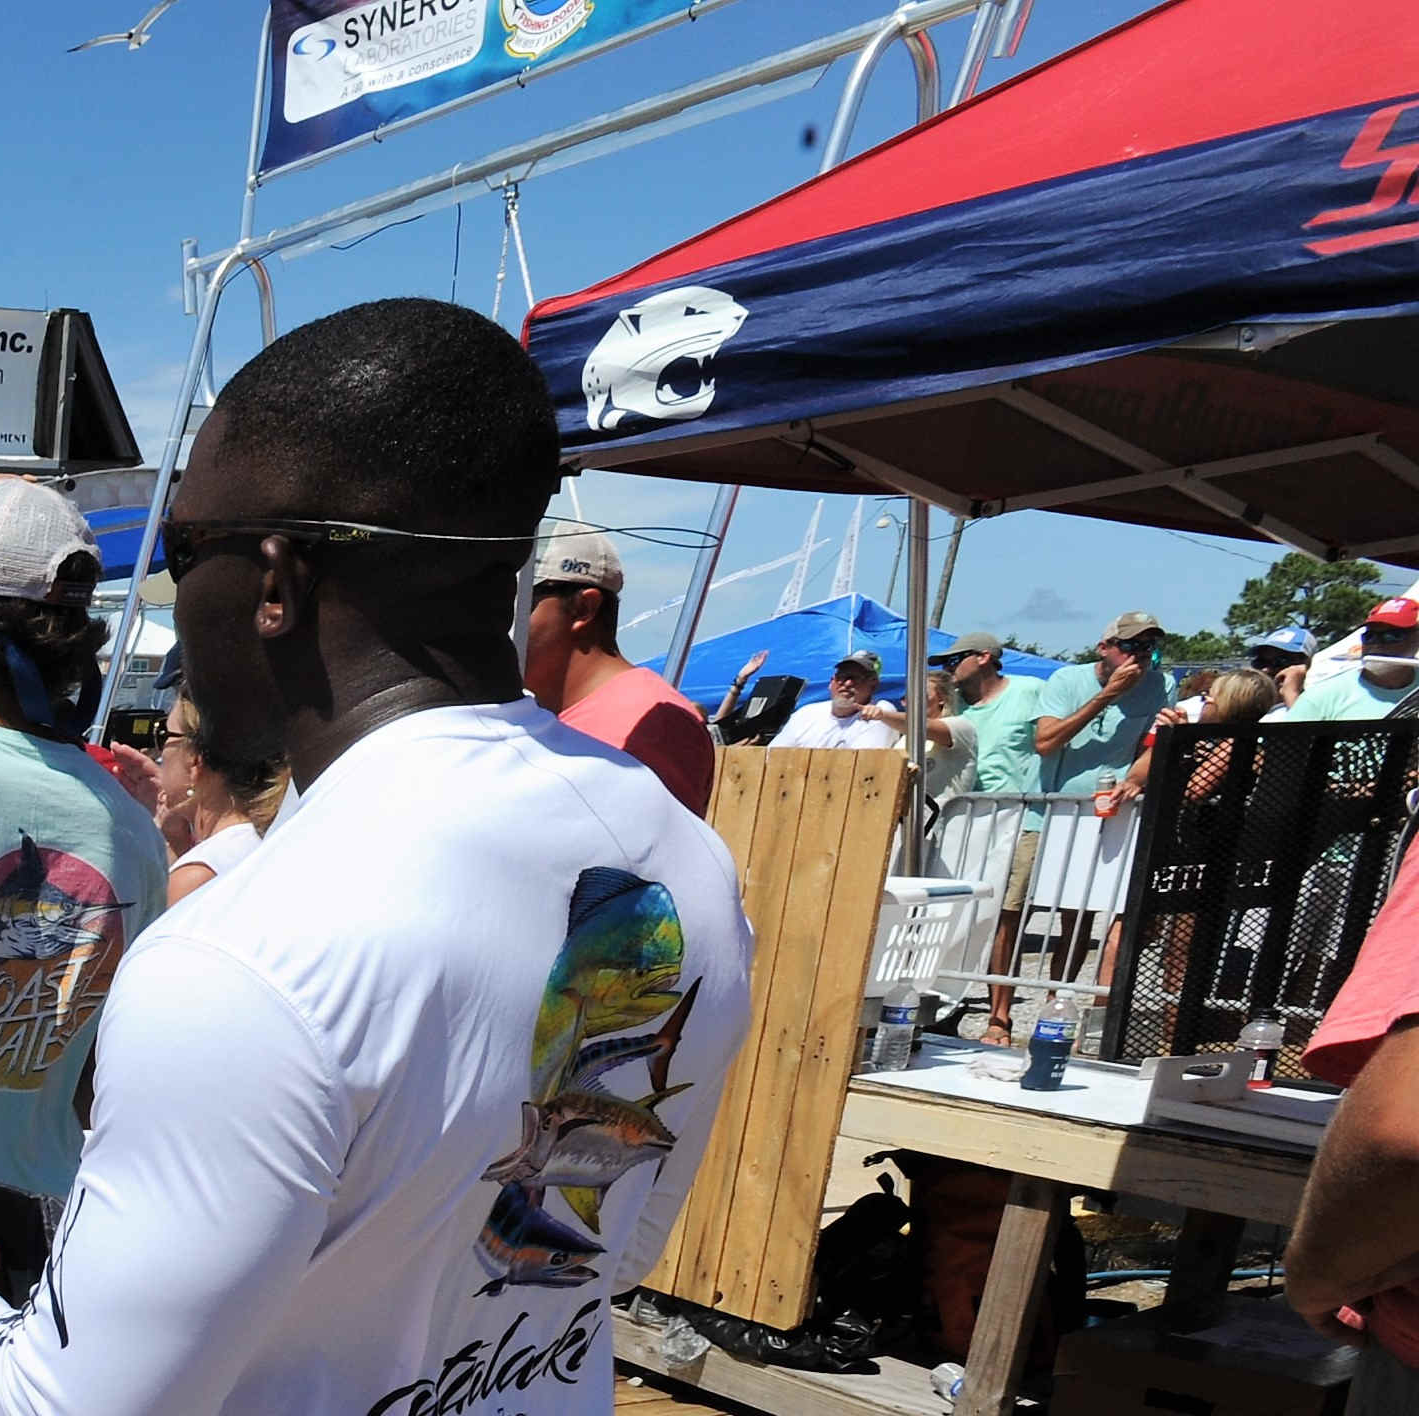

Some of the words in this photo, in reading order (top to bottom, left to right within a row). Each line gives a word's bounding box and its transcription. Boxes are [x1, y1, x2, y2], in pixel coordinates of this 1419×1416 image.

[343, 0, 475, 49] SYNER
[344, 8, 478, 77] LABORATORIES
[407, 46, 475, 80] conscience
